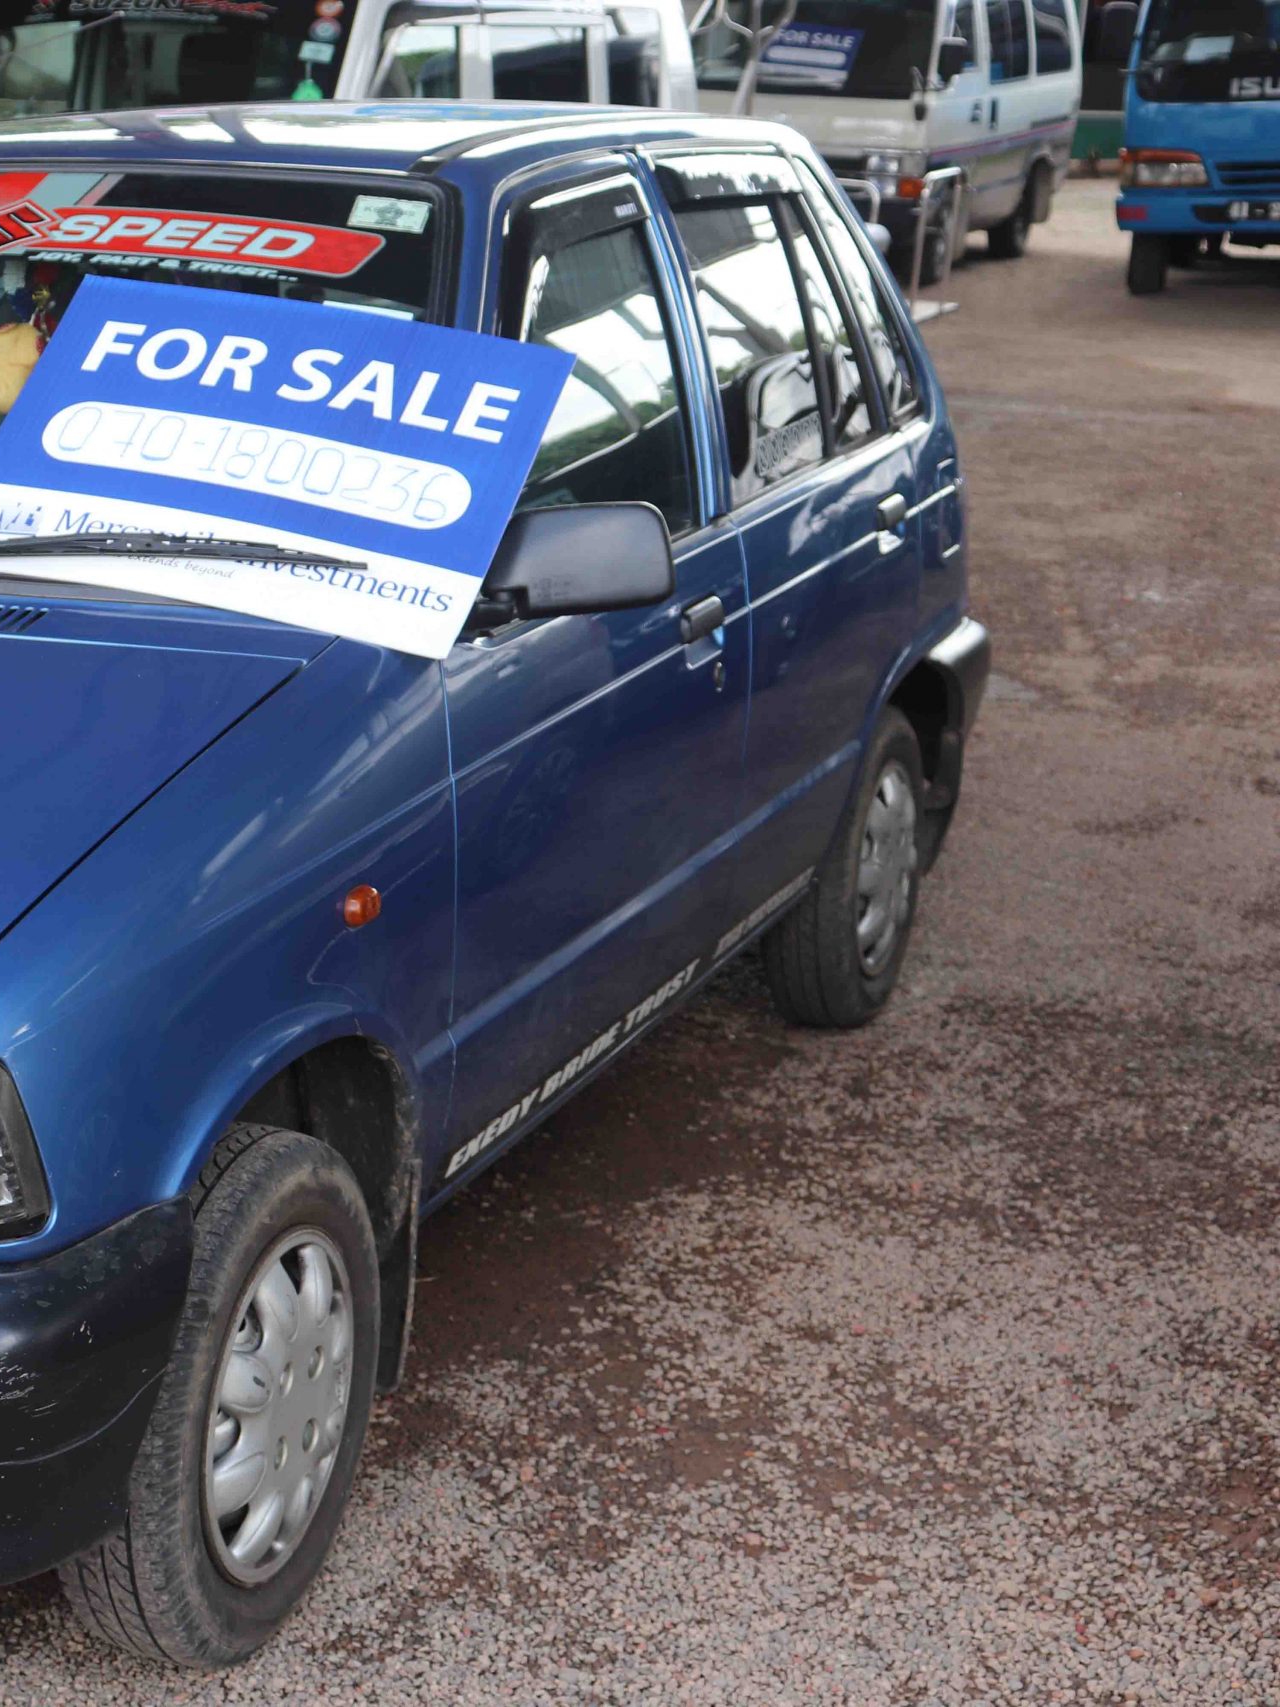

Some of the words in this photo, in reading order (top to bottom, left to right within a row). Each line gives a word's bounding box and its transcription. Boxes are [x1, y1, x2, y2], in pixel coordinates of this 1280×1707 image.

[811, 32, 856, 49] SALE
[51, 212, 315, 260] SPEED
[90, 254, 158, 268] FAST
[158, 259, 181, 269] &
[80, 320, 269, 393] FOR
[276, 348, 521, 444] SALE
[58, 406, 450, 523] 070-1800236
[184, 560, 235, 580] beyond
[234, 558, 453, 613] nvestments
